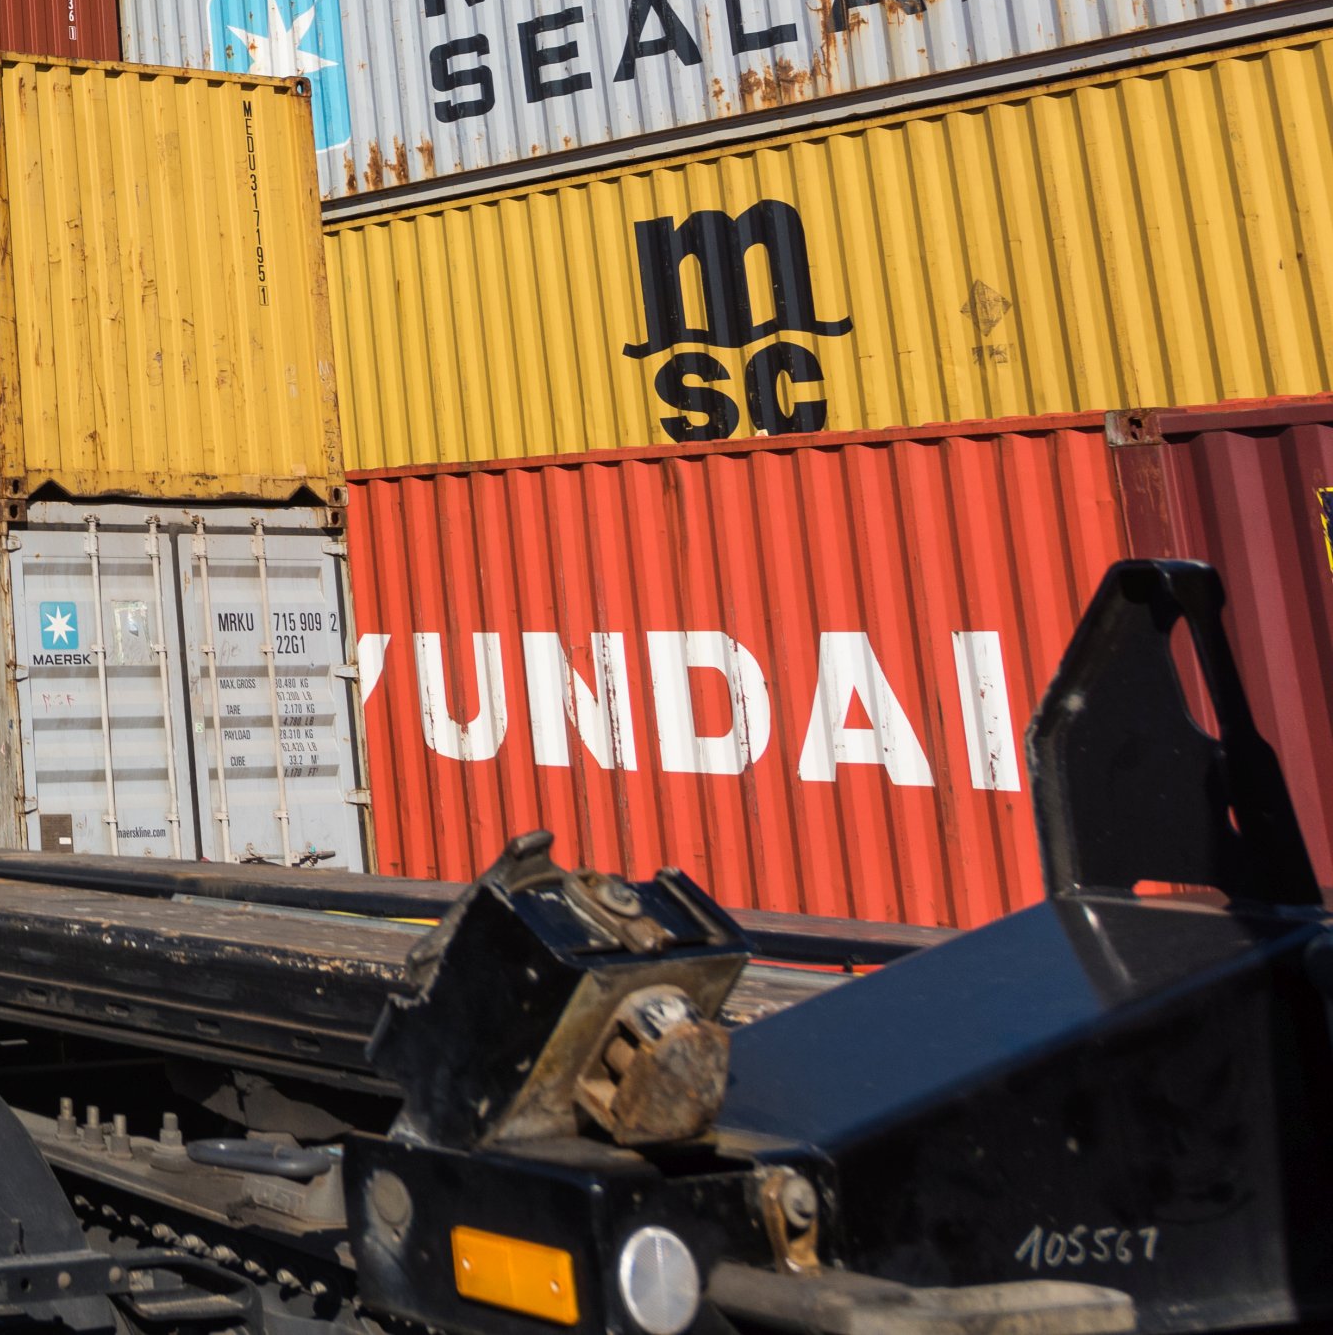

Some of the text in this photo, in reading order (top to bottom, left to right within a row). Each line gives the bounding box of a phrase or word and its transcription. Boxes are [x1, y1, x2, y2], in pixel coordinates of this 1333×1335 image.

[218, 613, 338, 633] MRKU 715 909 2
[276, 635, 306, 654] 22G1
[33, 654, 91, 665] MAERSK
[300, 678, 309, 688] KG
[304, 691, 312, 701] LB
[226, 703, 315, 715] TARE 2.170 KG
[283, 716, 314, 726] 4.780 LB
[224, 729, 251, 740] PAYLOAD
[305, 729, 314, 739] KG
[308, 741, 317, 751] LB
[230, 756, 246, 766] CUBE
[289, 755, 303, 765] 33.2
[284, 768, 302, 777] 1.170
